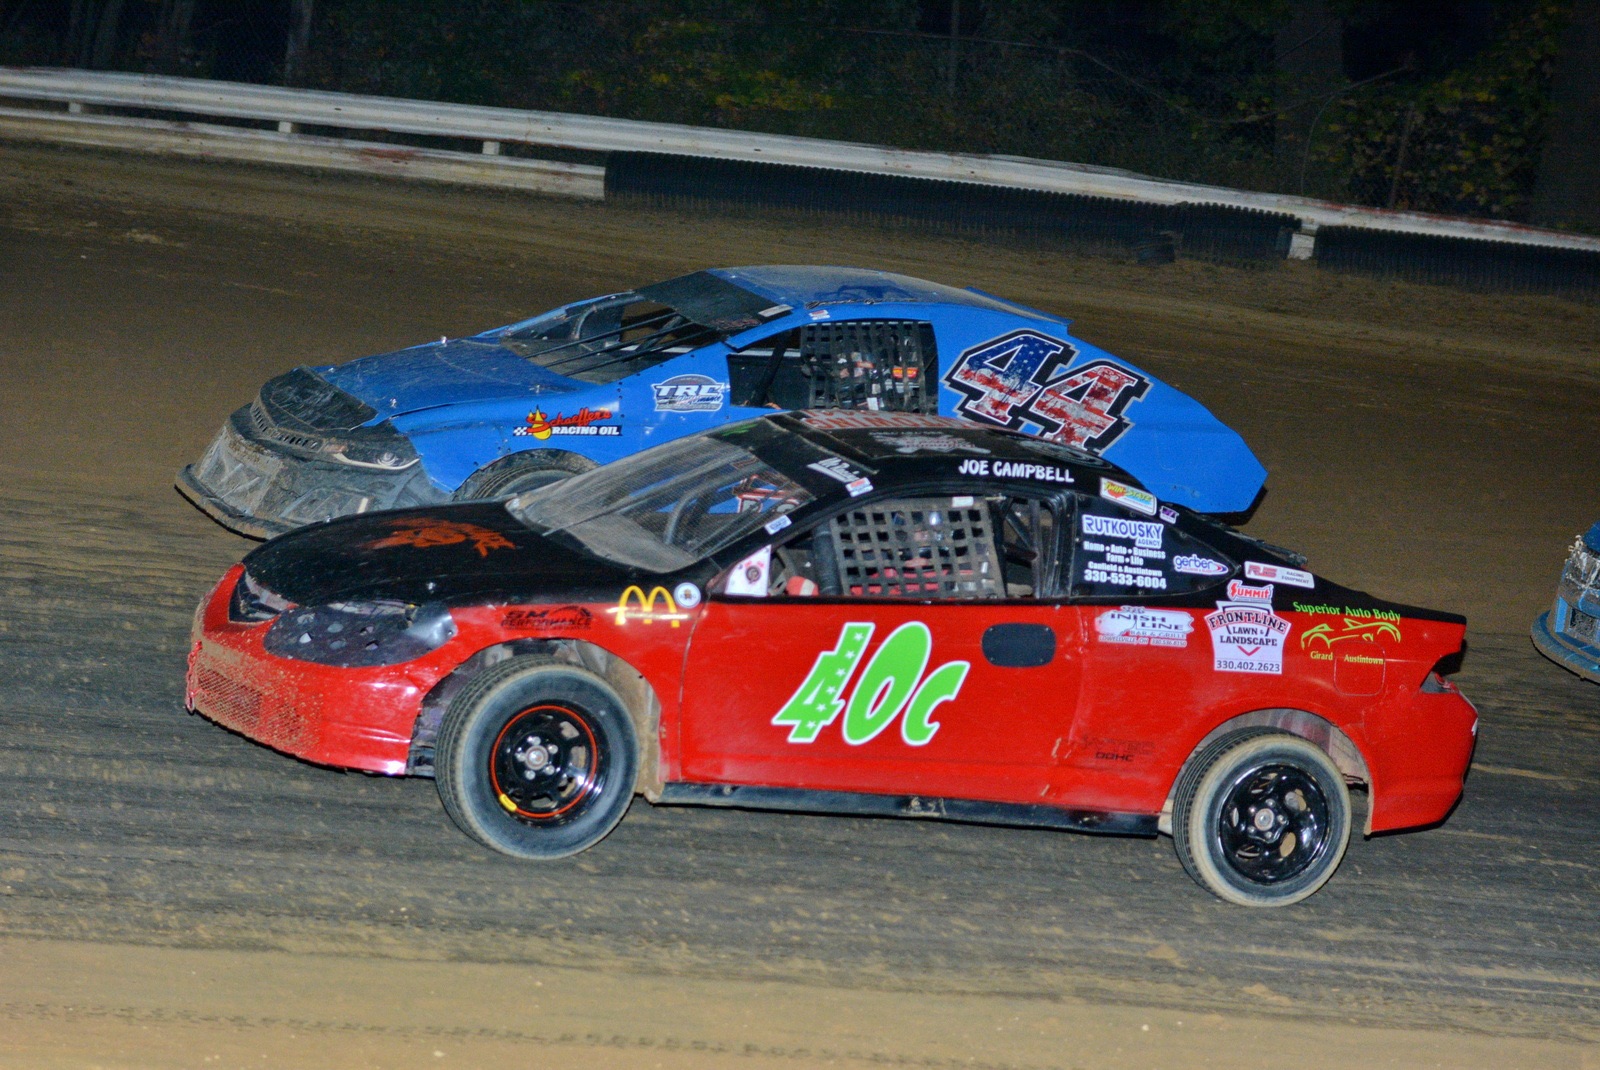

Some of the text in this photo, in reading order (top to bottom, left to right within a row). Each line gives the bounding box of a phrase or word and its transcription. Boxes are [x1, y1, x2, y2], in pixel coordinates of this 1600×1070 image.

[655, 384, 721, 396] TRC
[945, 330, 1147, 453] 44
[526, 406, 613, 433] Schaeffer's
[551, 425, 620, 436] RACING OIL
[958, 459, 1075, 483] JOE CAMPBELL
[1084, 516, 1162, 540] RUTKOUSKY
[1083, 541, 1166, 559] Home Auto Business
[1138, 538, 1161, 547] AGENCY
[1106, 552, 1144, 566] Farm Life
[1175, 555, 1214, 570] gerber
[1087, 561, 1118, 572] Canfield
[1124, 565, 1163, 577] Austintown
[1083, 569, 1167, 589] 330-533-6004
[1281, 575, 1310, 584] EQUIPMENT
[1292, 601, 1401, 625] Superior Auto Body
[1208, 611, 1287, 632] FRONTLINE
[1232, 626, 1258, 635] LAWN
[1219, 636, 1278, 647] LANDSCAPE
[1310, 650, 1385, 665] Girard Austintown
[1216, 659, 1280, 673] 330.402.2623
